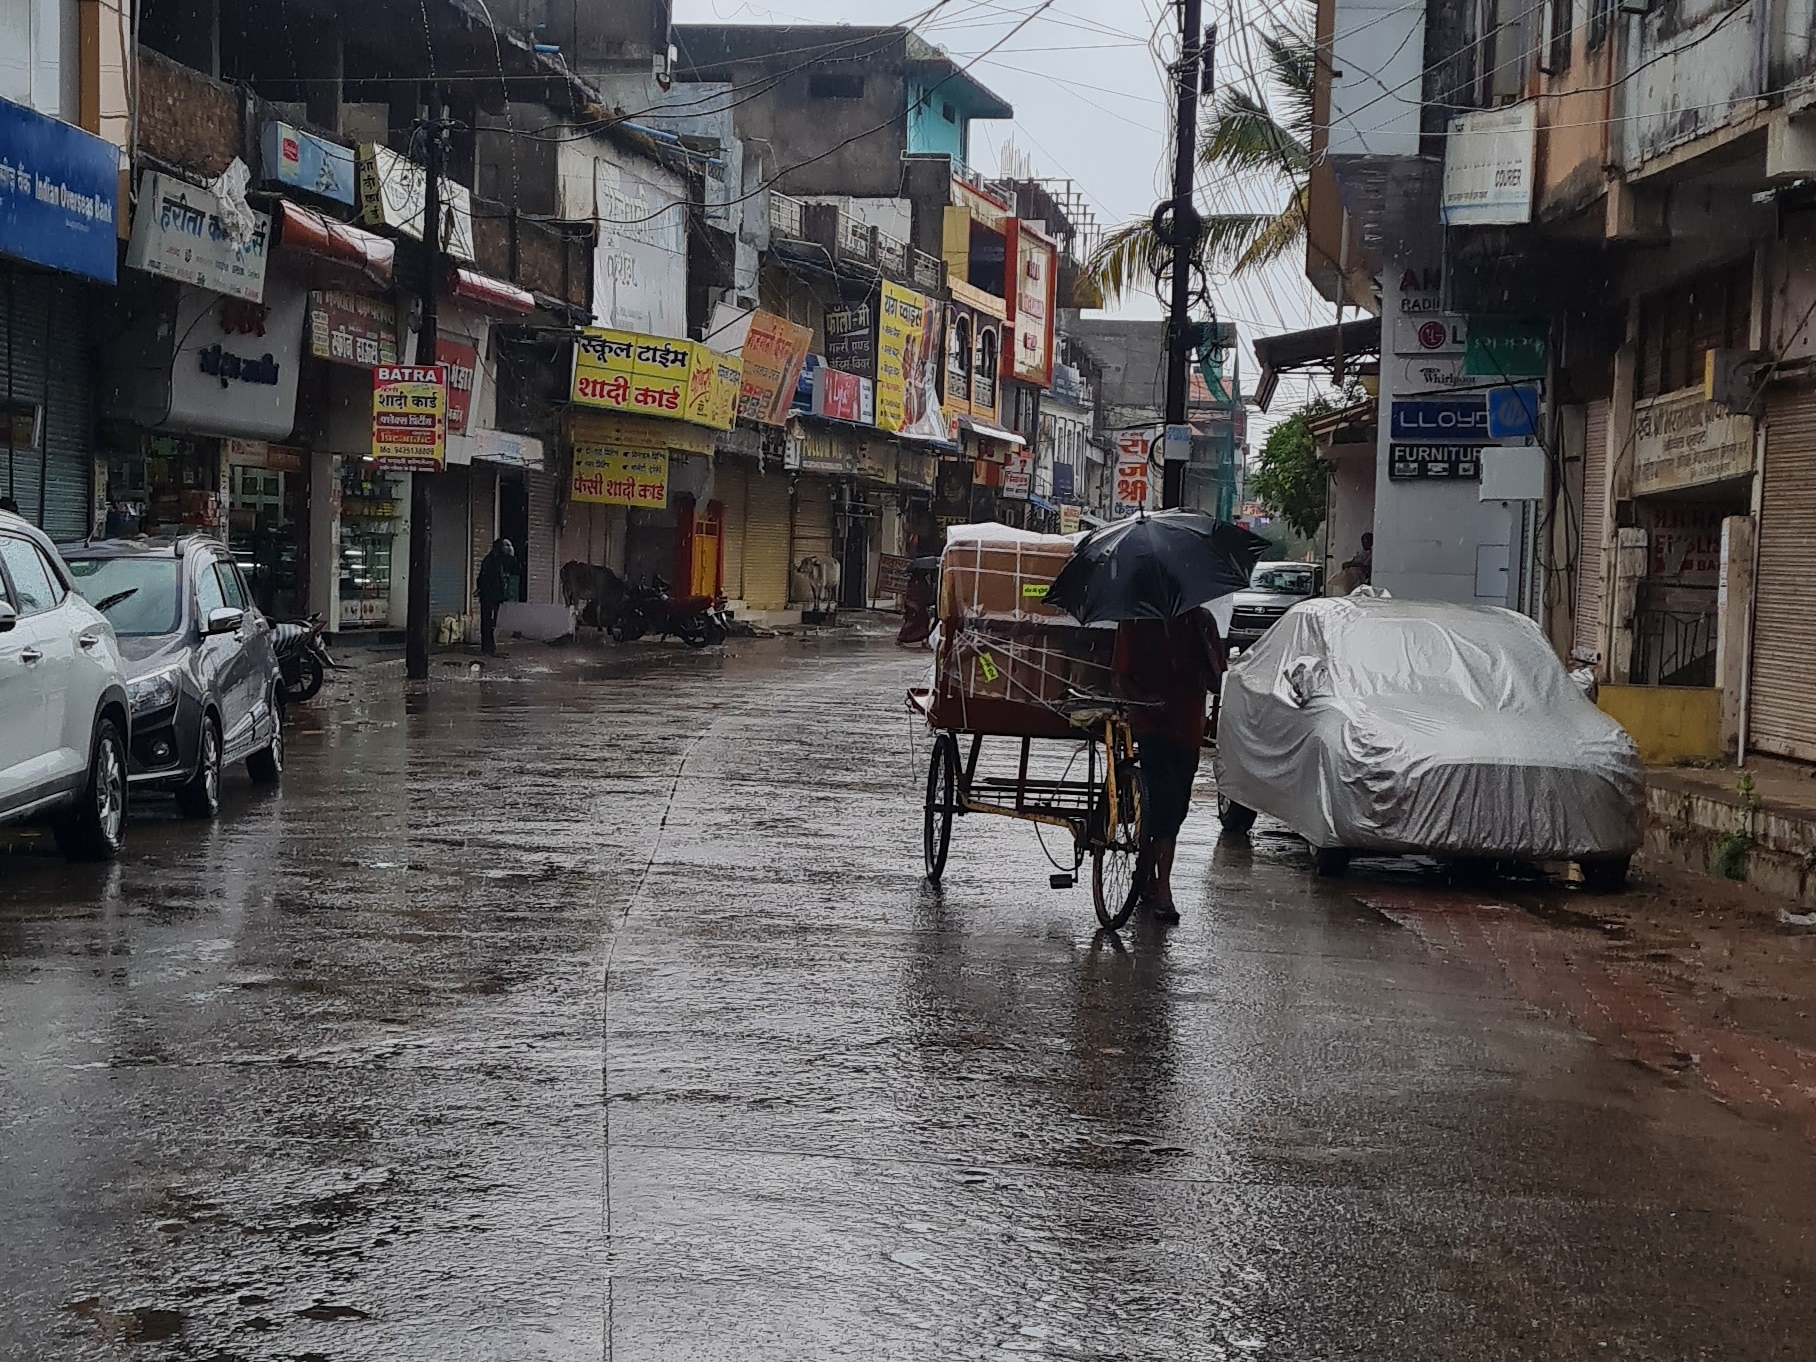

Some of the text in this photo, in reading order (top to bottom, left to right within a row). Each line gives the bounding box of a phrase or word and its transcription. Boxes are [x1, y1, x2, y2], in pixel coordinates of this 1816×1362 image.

[35, 172, 60, 206] Indian
[60, 182, 94, 220] Overseas
[94, 194, 113, 224] Bank
[378, 367, 437, 382] BATRA
[378, 391, 437, 409] शादी कार्ड
[578, 375, 630, 405] शादी
[634, 386, 681, 410] कार्ड
[1395, 447, 1481, 461] FURNITUR
[606, 476, 635, 501] शादी
